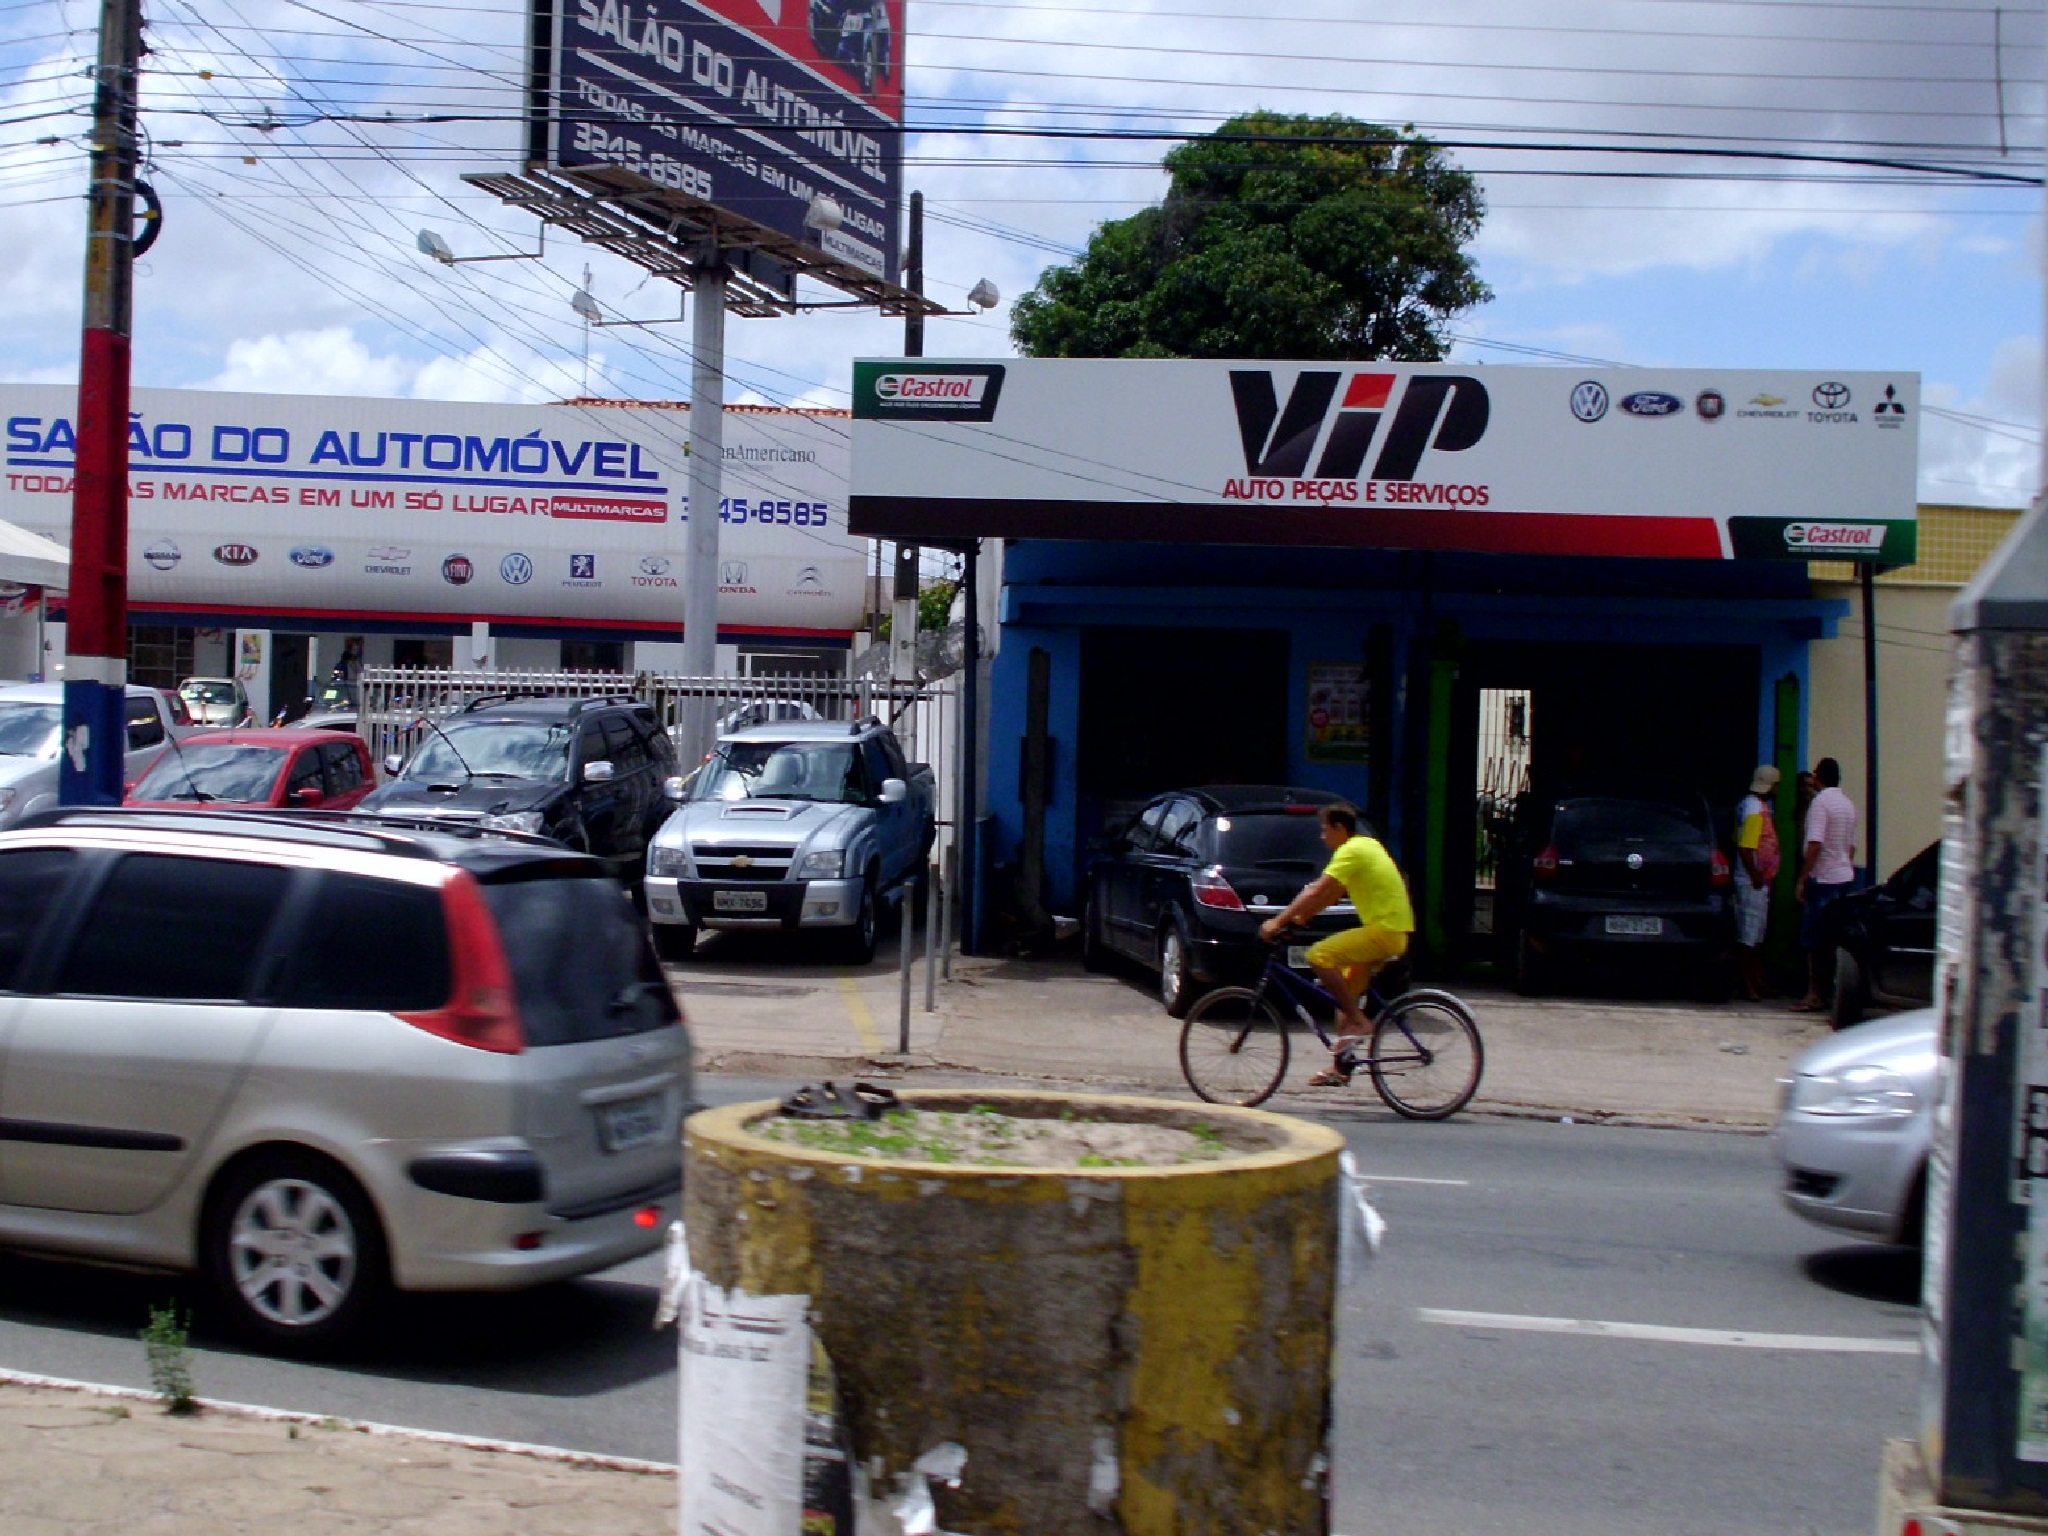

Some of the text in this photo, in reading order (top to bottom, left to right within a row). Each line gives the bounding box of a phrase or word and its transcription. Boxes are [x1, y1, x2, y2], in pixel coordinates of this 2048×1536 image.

[577, 0, 886, 184] SALÃO DO AUTOMÓVEL
[576, 77, 644, 122] TODAS
[650, 113, 677, 140] AS
[681, 126, 757, 177] MARCAS
[761, 164, 785, 190] EM
[789, 176, 813, 203] UM
[573, 122, 712, 200] 3245-8585
[901, 377, 972, 397] Castrol
[1808, 411, 1858, 423] TOYOTA
[6, 412, 659, 479] SAÃO DO AUTOMÓVEL
[721, 444, 816, 462] nAmericano
[6, 473, 75, 493] TODA
[163, 482, 289, 503] MARCAS
[299, 488, 340, 507] EM
[351, 490, 394, 509] UM
[405, 489, 443, 511] SÓ
[453, 495, 549, 515] LUGAR
[1222, 479, 1489, 511] AUTO PEÇAS E SERVIÇOS
[552, 502, 665, 518] MULTIMARCAS
[681, 495, 827, 526] 45-8585
[1807, 525, 1871, 543] Castrol
[221, 546, 253, 560] KIA
[365, 565, 411, 576] CHEVROLET
[631, 576, 677, 588] TOYOTA
[718, 586, 757, 594] ONDA
